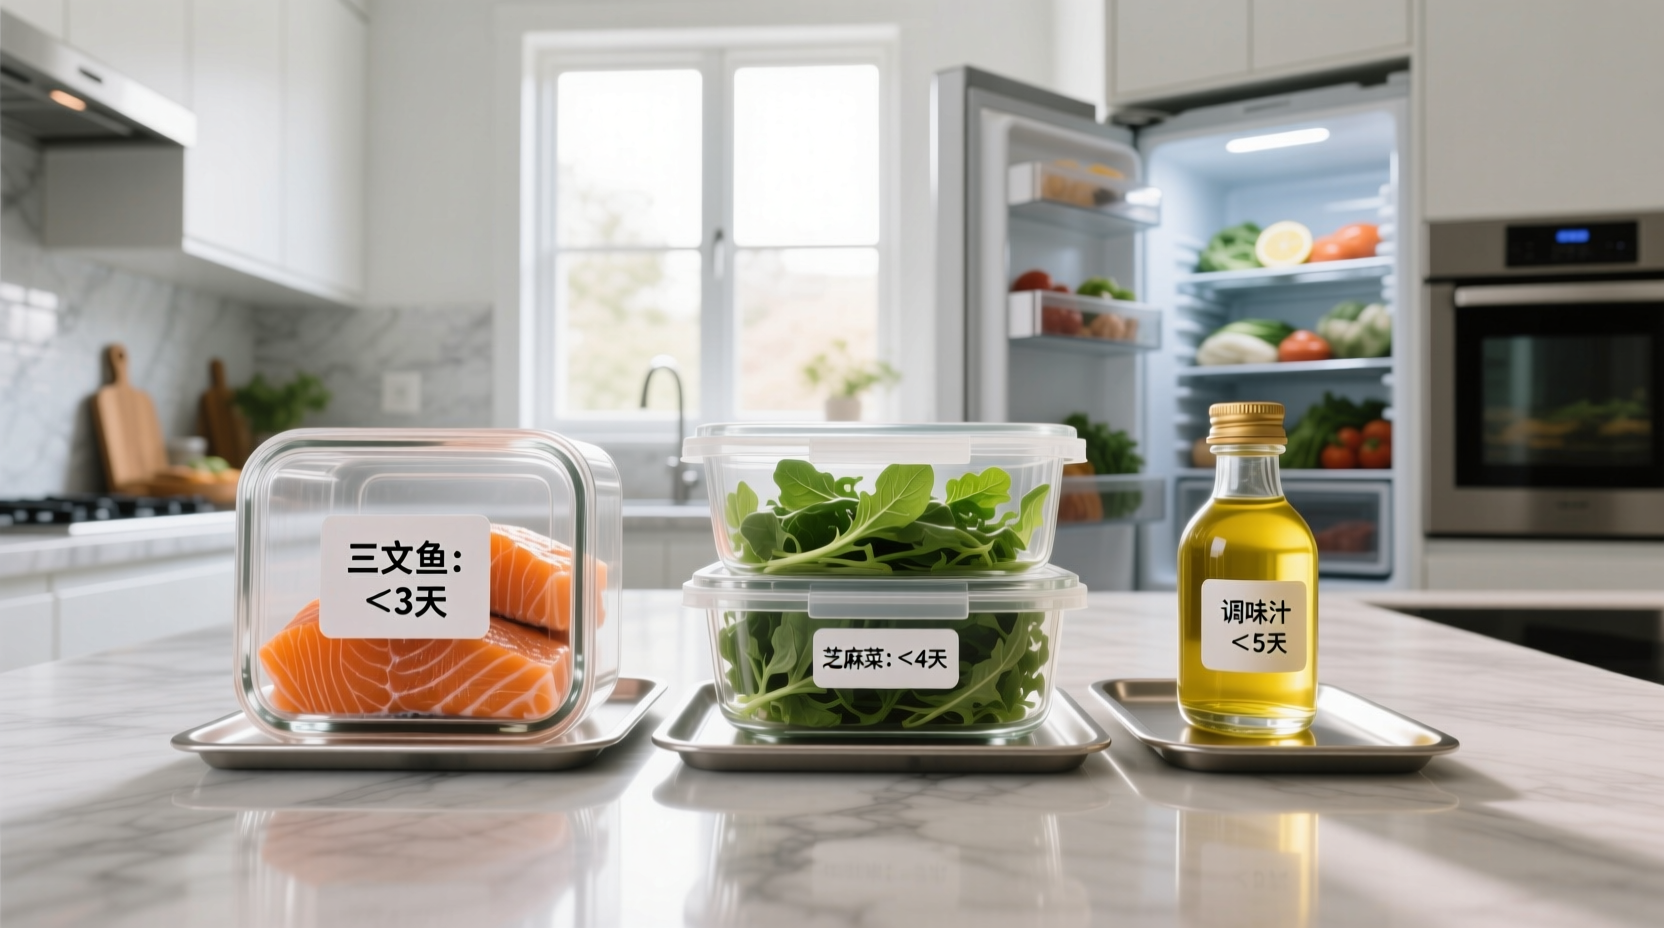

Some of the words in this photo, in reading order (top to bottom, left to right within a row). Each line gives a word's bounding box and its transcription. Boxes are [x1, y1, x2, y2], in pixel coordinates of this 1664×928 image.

[365, 586, 448, 618] <3天
[1220, 599, 1291, 625] 调味汁
[1231, 632, 1288, 655] <5天
